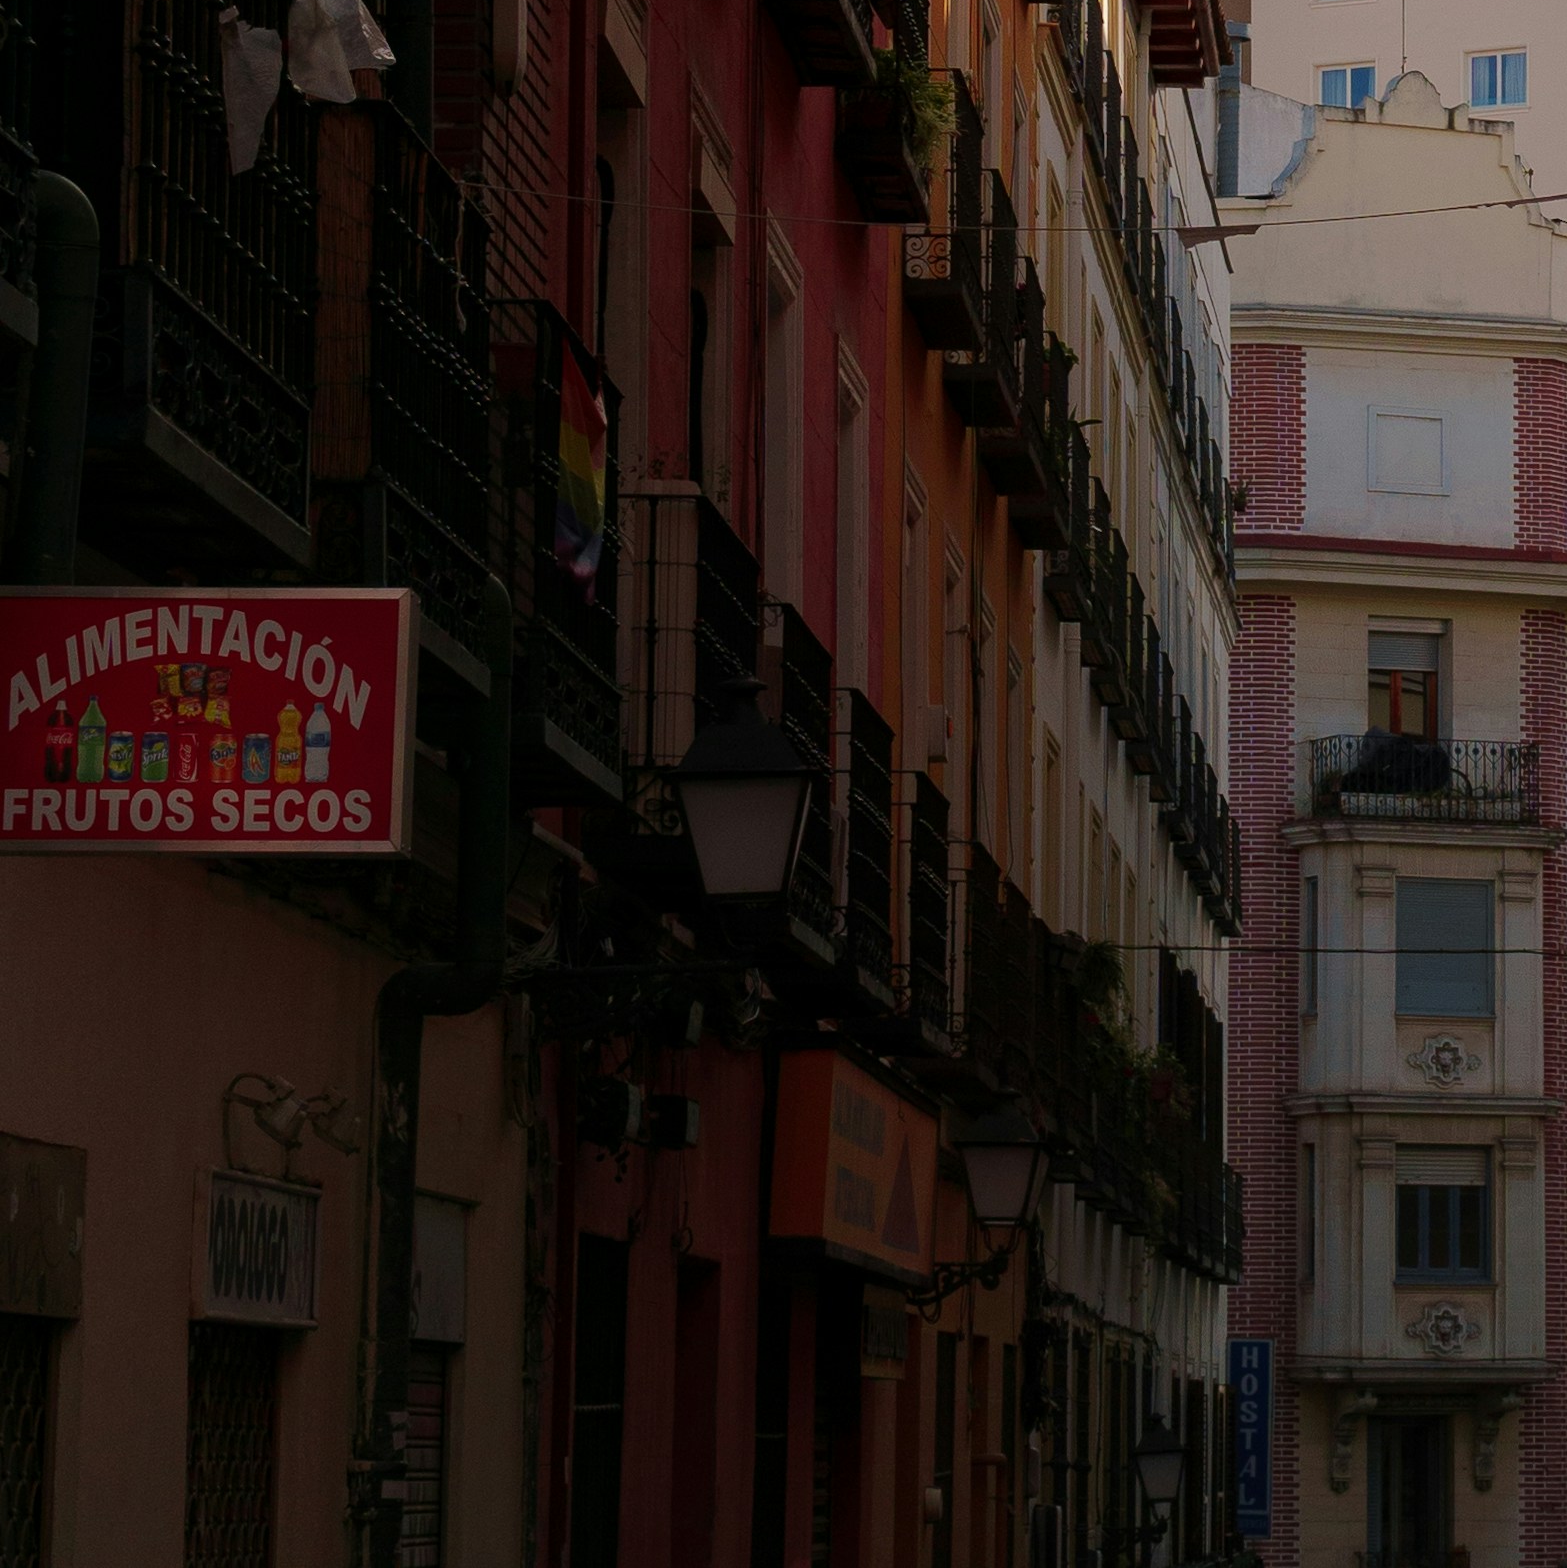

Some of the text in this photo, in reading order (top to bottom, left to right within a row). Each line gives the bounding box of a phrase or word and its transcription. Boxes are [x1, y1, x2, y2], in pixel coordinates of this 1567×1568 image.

[8, 604, 372, 732] ALIMENTACIÓN
[2, 788, 372, 833] FRUTOS SECOS
[1237, 1345, 1260, 1507] HOSTAL
